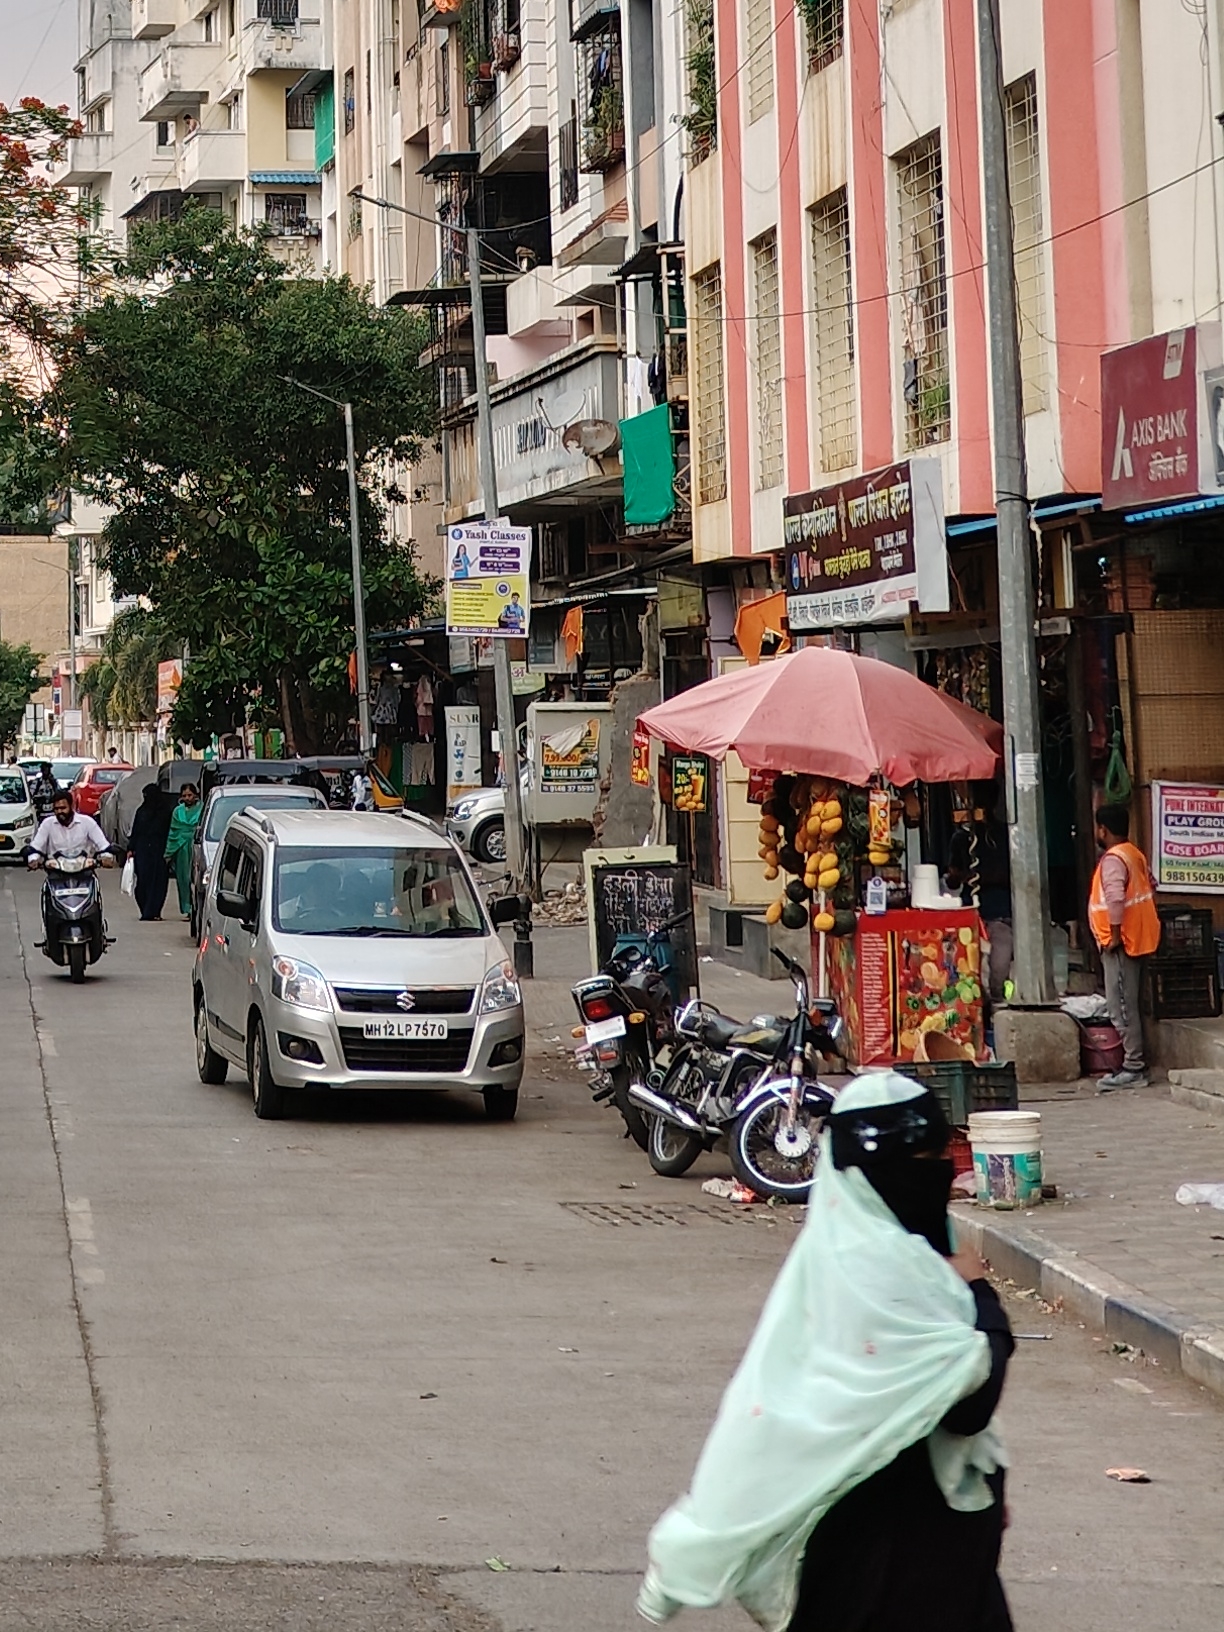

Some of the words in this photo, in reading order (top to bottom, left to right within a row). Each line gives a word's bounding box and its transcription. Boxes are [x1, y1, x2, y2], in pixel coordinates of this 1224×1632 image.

[1131, 417, 1155, 448] AXIS
[1156, 409, 1187, 442] BANK
[464, 529, 488, 540] Yash
[490, 530, 526, 540] Classes
[1167, 816, 1195, 826] PLAY
[1166, 843, 1192, 856] CBSE
